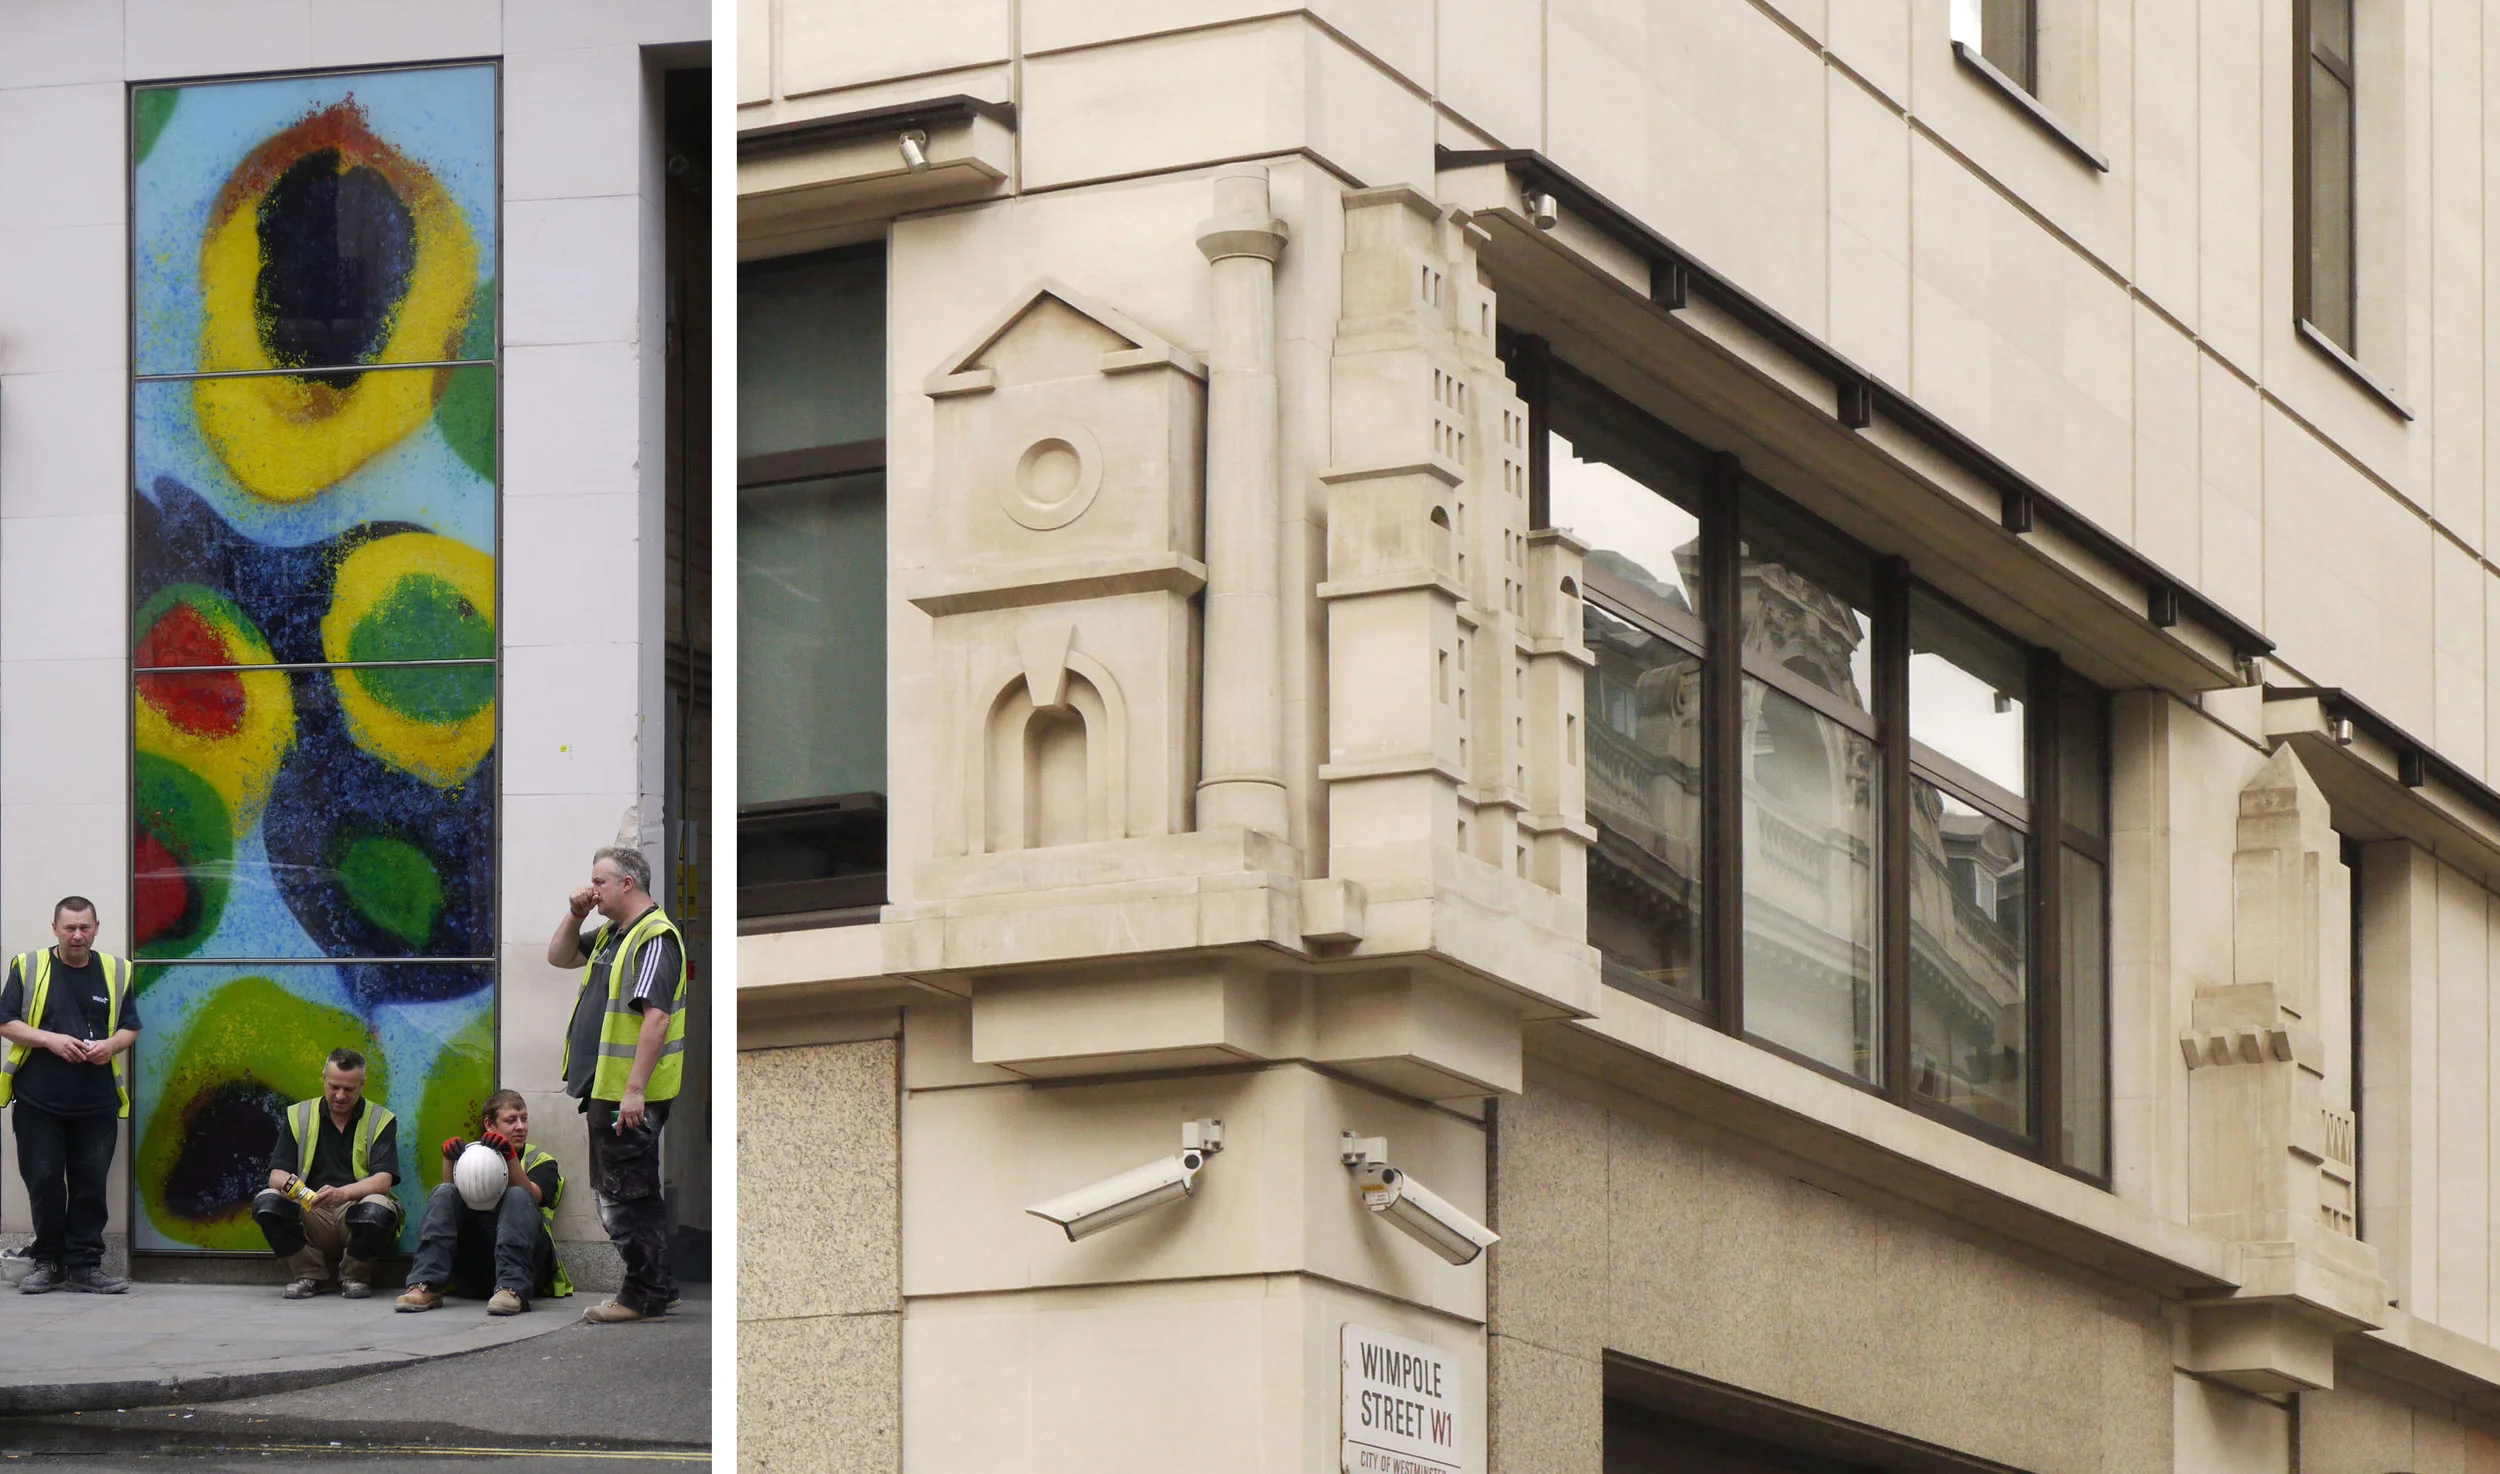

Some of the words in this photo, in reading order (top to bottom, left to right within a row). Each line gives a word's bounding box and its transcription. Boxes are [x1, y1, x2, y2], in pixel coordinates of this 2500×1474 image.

[1360, 1341, 1443, 1399] WIMPOLE
[1361, 1389, 1425, 1440] STREET
[1430, 1407, 1452, 1448] W1
[1360, 1450, 1379, 1470] CITY
[1380, 1455, 1391, 1472] OF
[1393, 1458, 1448, 1474] WESTMIN
